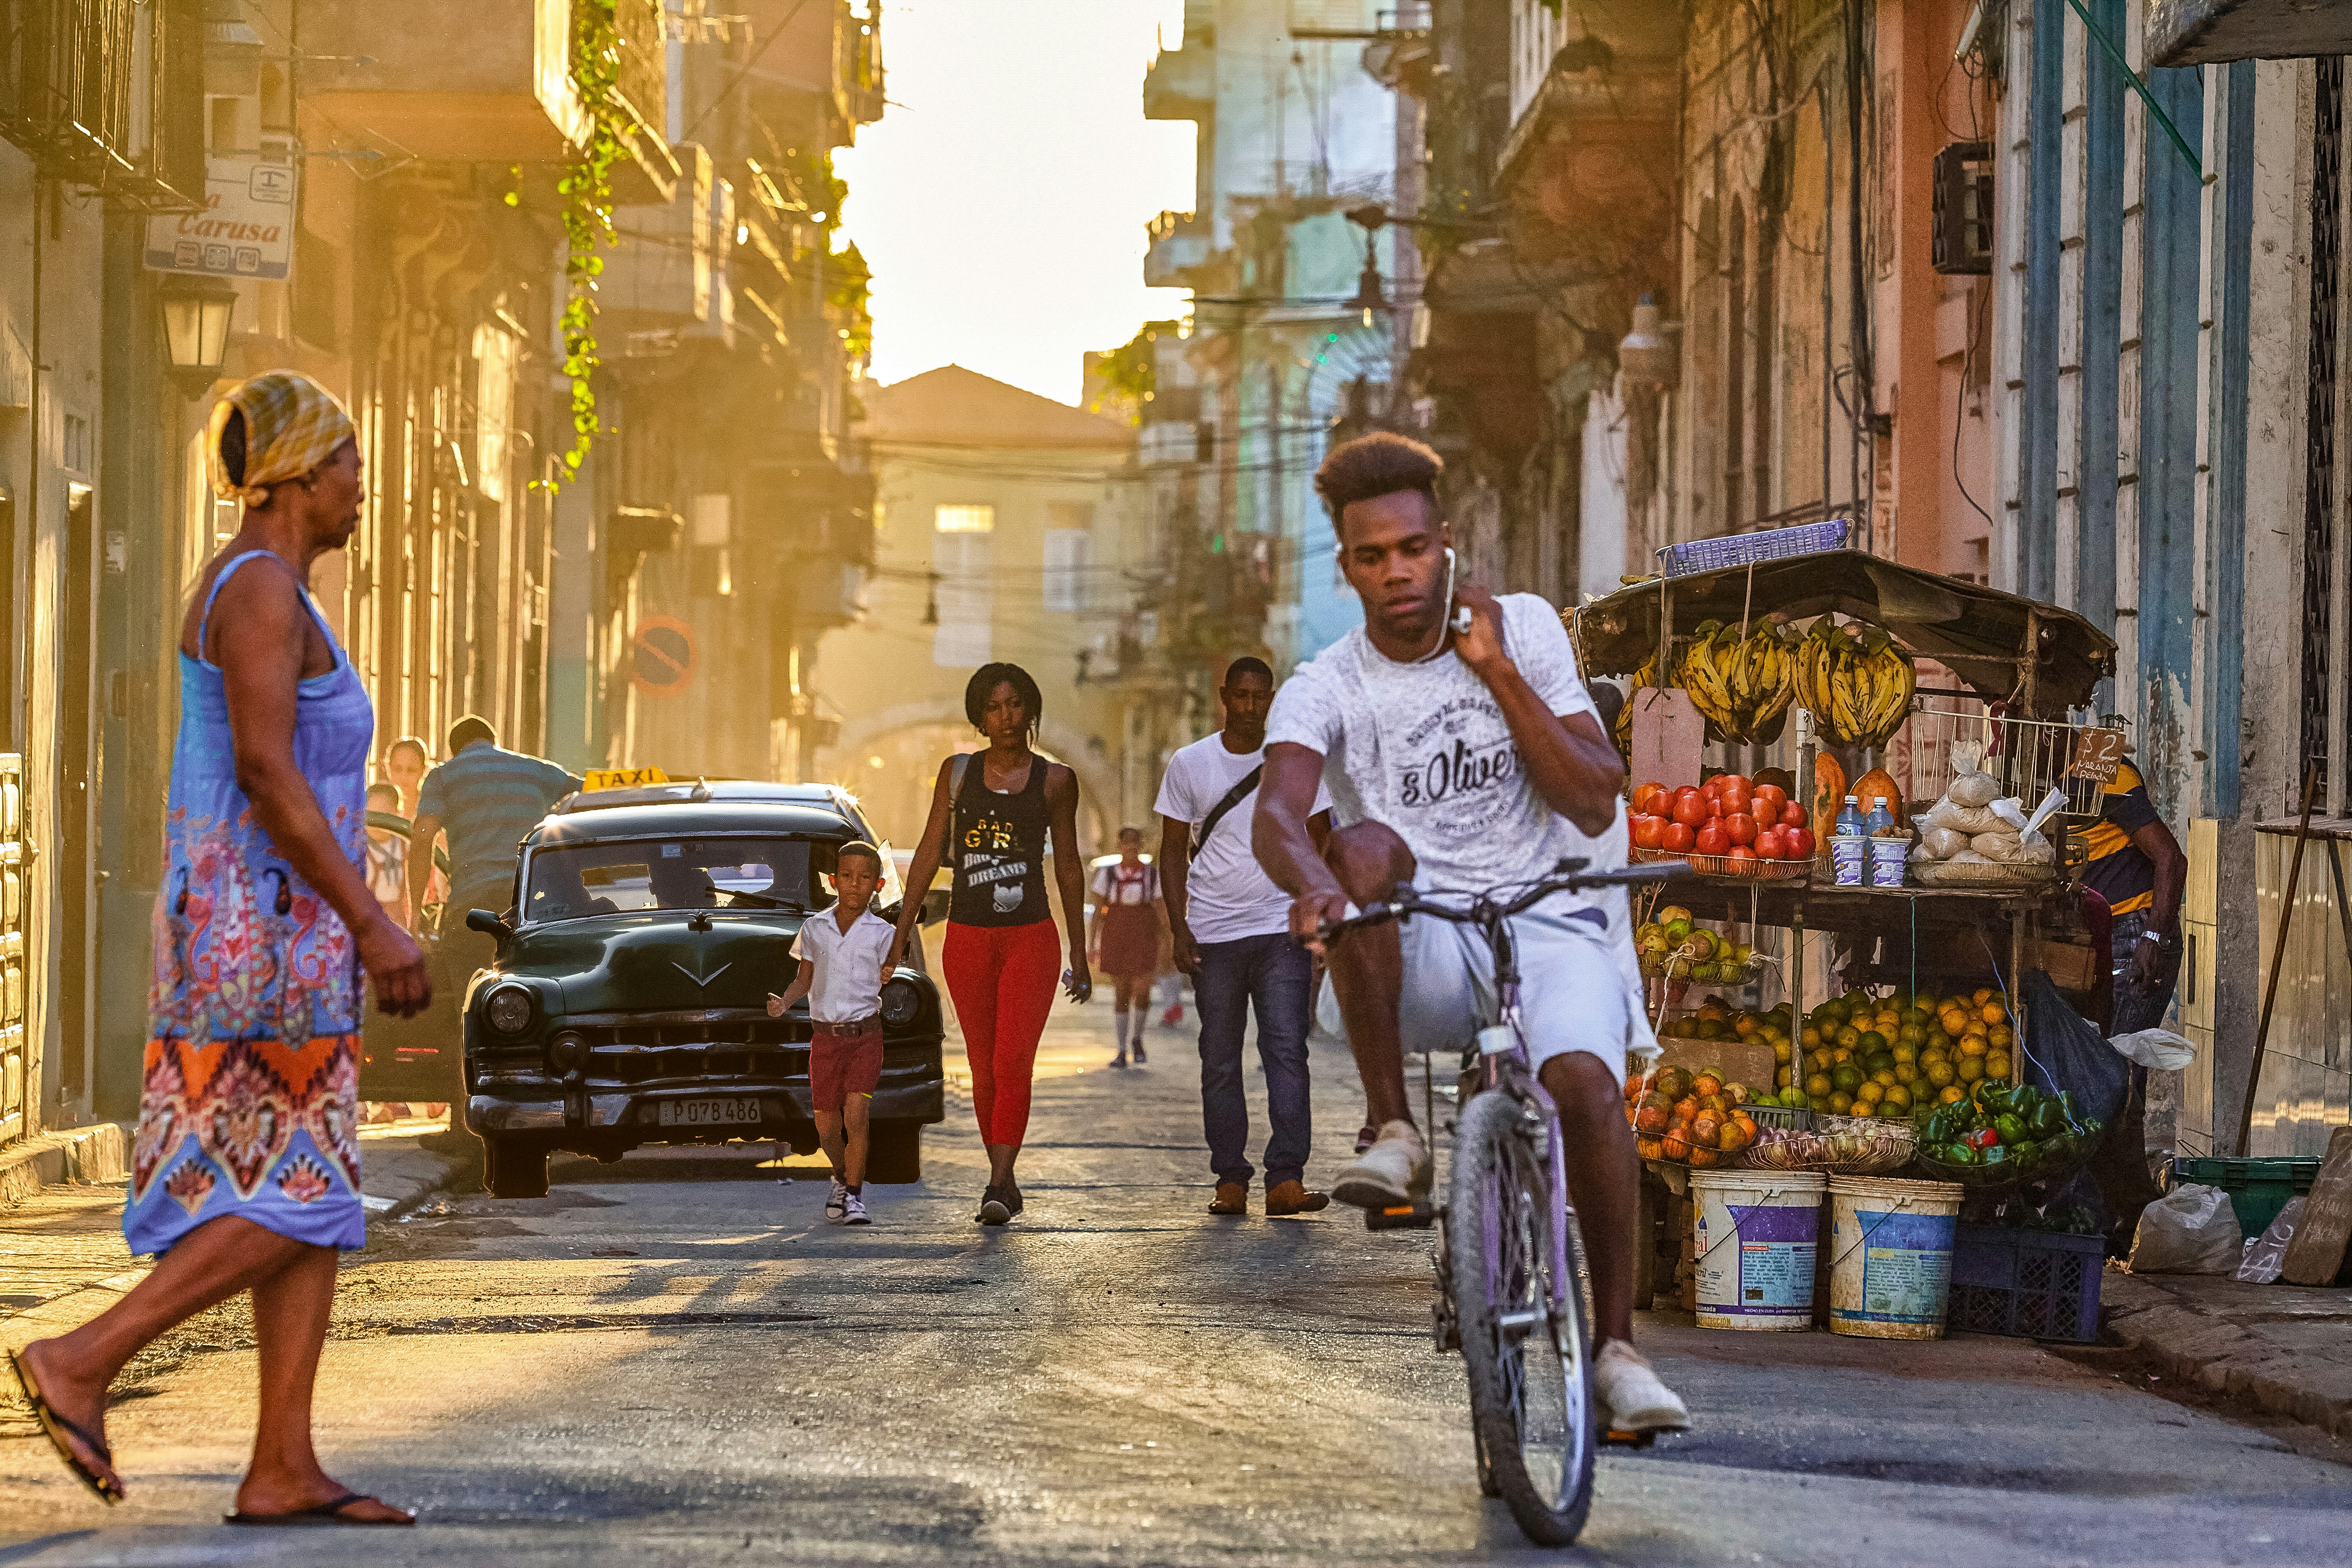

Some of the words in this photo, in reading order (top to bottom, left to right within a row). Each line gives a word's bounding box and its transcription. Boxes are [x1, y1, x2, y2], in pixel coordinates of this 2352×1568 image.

[177, 213, 282, 243] Carusa
[2076, 759, 2117, 775] NARANJA
[595, 769, 653, 787] TAXI
[978, 819, 1014, 832] BAD
